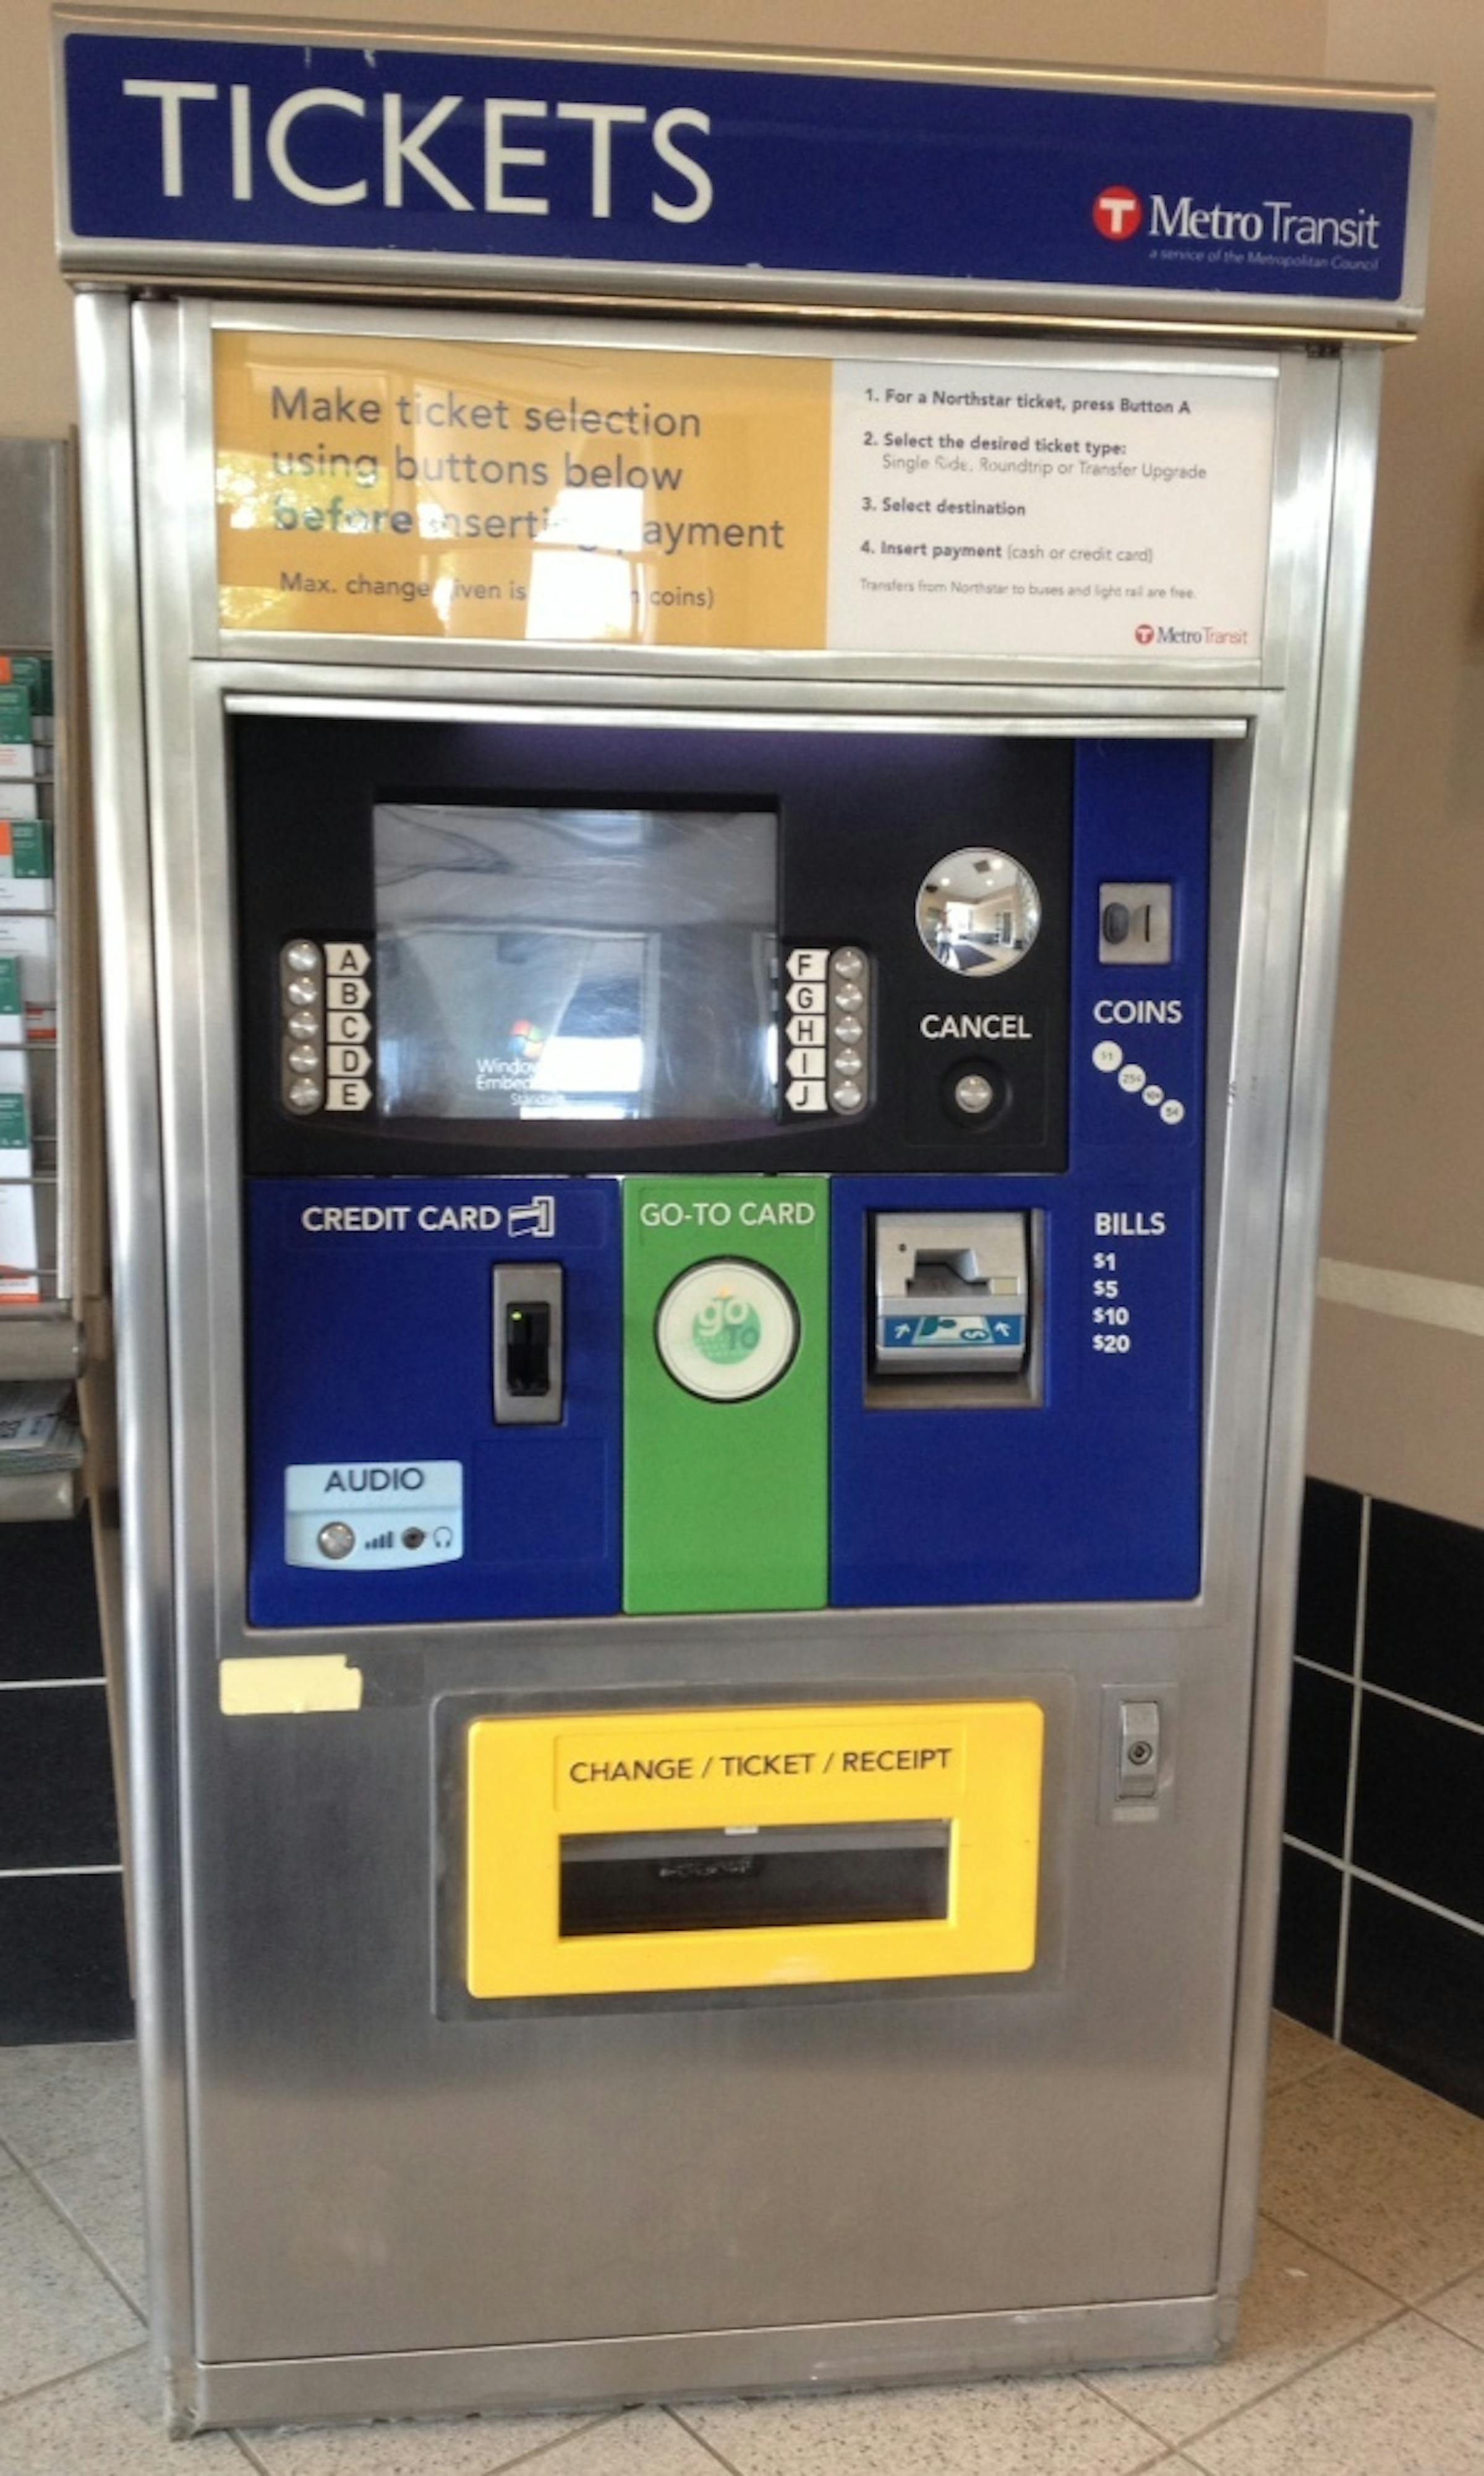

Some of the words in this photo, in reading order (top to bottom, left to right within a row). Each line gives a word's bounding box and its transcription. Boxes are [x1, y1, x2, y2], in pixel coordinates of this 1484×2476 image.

[124, 79, 714, 224] TICKETS
[1149, 251, 1158, 259] a
[1161, 250, 1204, 262] service
[1208, 249, 1222, 262] of
[1224, 250, 1245, 264] the
[1247, 251, 1329, 269] Metropolitan
[1330, 255, 1380, 271] Council
[271, 386, 382, 425] Make
[396, 391, 510, 430] ticket
[524, 396, 701, 438] selection
[865, 388, 879, 402] 1.
[885, 388, 913, 404] For
[918, 393, 927, 404] a
[932, 390, 1011, 408] Northstar
[1016, 393, 1067, 411] ticket,
[1072, 398, 1115, 414] press
[1120, 397, 1174, 413] Button
[1177, 401, 1191, 414] A
[863, 431, 878, 446] 2.
[884, 432, 934, 448] Select
[939, 433, 965, 449] the
[970, 434, 1030, 451] desired
[1034, 438, 1080, 454] ticket
[1085, 440, 1127, 458] type:
[271, 443, 378, 488] using
[394, 444, 549, 487] buttons
[565, 451, 683, 491] below
[882, 453, 929, 474] Single
[979, 456, 1054, 478] Roundtrip
[1057, 463, 1073, 476] or
[1079, 461, 1138, 477] Transfer
[1141, 463, 1208, 482] Upgrade
[862, 497, 877, 512] 3.
[882, 497, 932, 513] Select
[936, 498, 1026, 516] destination
[273, 495, 413, 534] before
[617, 518, 785, 555] ayment
[860, 539, 876, 555] 4.
[881, 542, 927, 557] Insert
[932, 543, 1002, 561] payment
[1007, 544, 1044, 561] (cash
[1050, 547, 1065, 560] or
[1068, 546, 1113, 561] credit
[1116, 547, 1154, 564] card)
[279, 571, 337, 594] Max.
[346, 573, 430, 602] change
[440, 579, 503, 600] iven
[509, 580, 528, 600] is
[650, 587, 715, 611] coins)
[861, 578, 915, 593] Transfers
[919, 579, 947, 593] from
[951, 581, 1009, 595] Northstar
[1012, 583, 1026, 596] to
[1029, 583, 1064, 596] buses
[1067, 583, 1091, 597] and
[1095, 584, 1122, 600] light
[1125, 584, 1143, 598] rail
[1147, 587, 1166, 599] are
[1170, 585, 1197, 599] free.
[339, 949, 359, 971] A
[798, 954, 812, 976] F
[341, 983, 359, 1005] B
[796, 988, 814, 1009] G
[1093, 999, 1183, 1024] COINS
[341, 1017, 358, 1039] C
[798, 1020, 814, 1042] H
[920, 1014, 1033, 1039] CANCEL
[341, 1051, 360, 1072] D
[342, 1083, 358, 1106] E
[795, 1086, 808, 1107] J
[301, 1206, 411, 1232] CREDIT
[417, 1205, 501, 1232] CARD
[639, 1203, 731, 1227] GO-TO
[739, 1202, 816, 1226] CARD
[1094, 1211, 1166, 1236] BILLS
[1093, 1252, 1116, 1271] $1
[1092, 1279, 1119, 1299] $5
[1092, 1305, 1130, 1326] $10
[1092, 1333, 1131, 1354] $20
[324, 1467, 425, 1493] AUDIO
[569, 1757, 693, 1783] CHANGE
[720, 1752, 816, 1777] TICKET
[842, 1748, 953, 1773] RECEIPT
